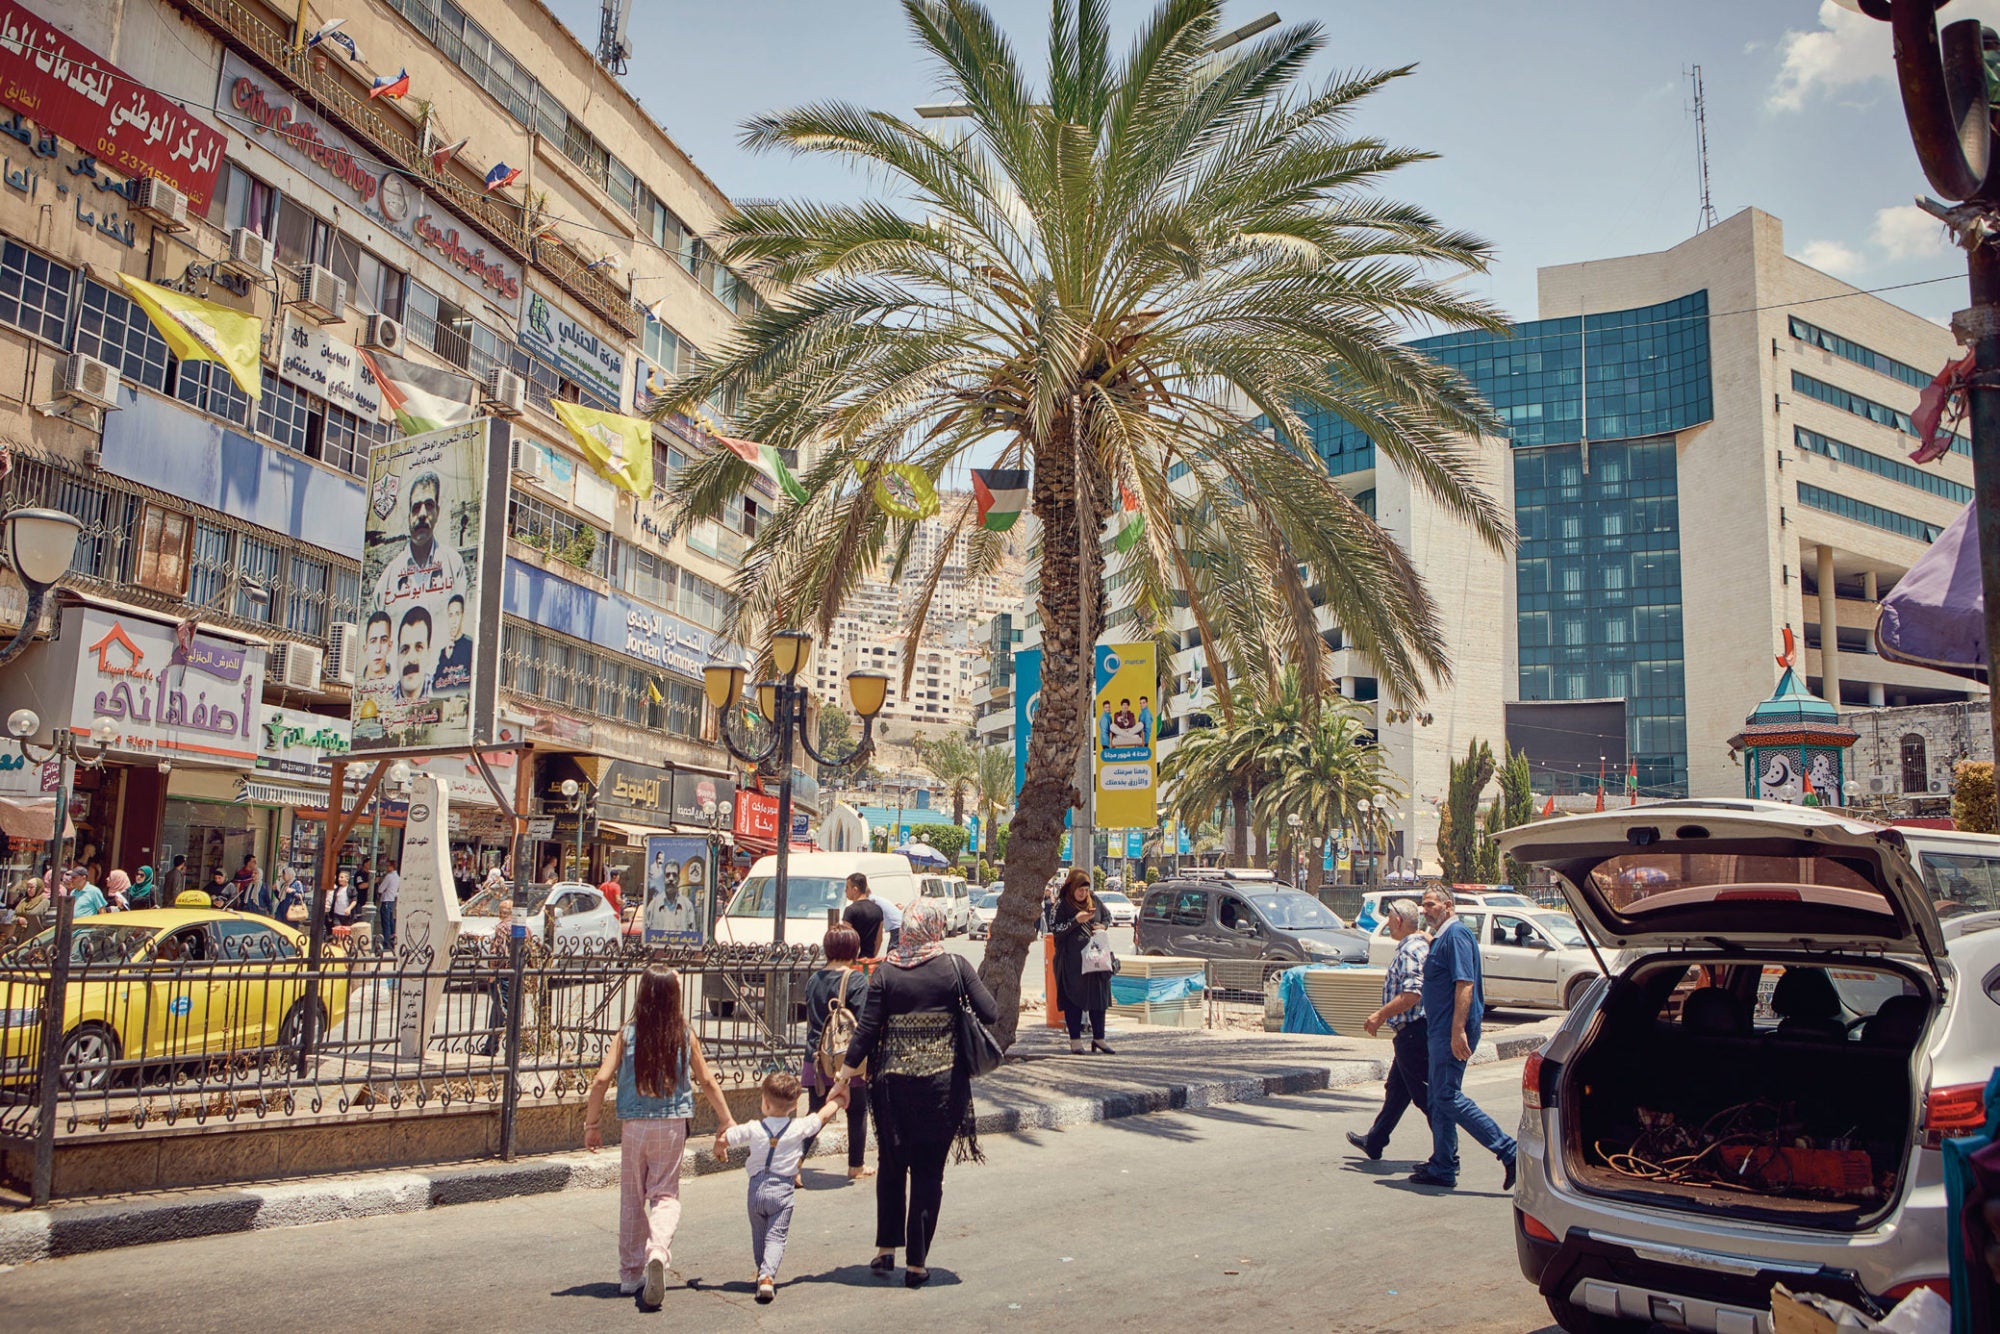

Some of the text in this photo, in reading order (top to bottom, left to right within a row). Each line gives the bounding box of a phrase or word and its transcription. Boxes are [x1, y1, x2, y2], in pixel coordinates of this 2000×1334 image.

[35, 31, 113, 107] للخدمات
[110, 91, 176, 146] الوطني
[233, 77, 376, 203] City Coffee Shop
[98, 137, 116, 156] 09
[169, 118, 221, 174] المركز
[559, 322, 598, 358] الحنبلي
[600, 348, 620, 374] شركة
[625, 632, 660, 661] Jordan
